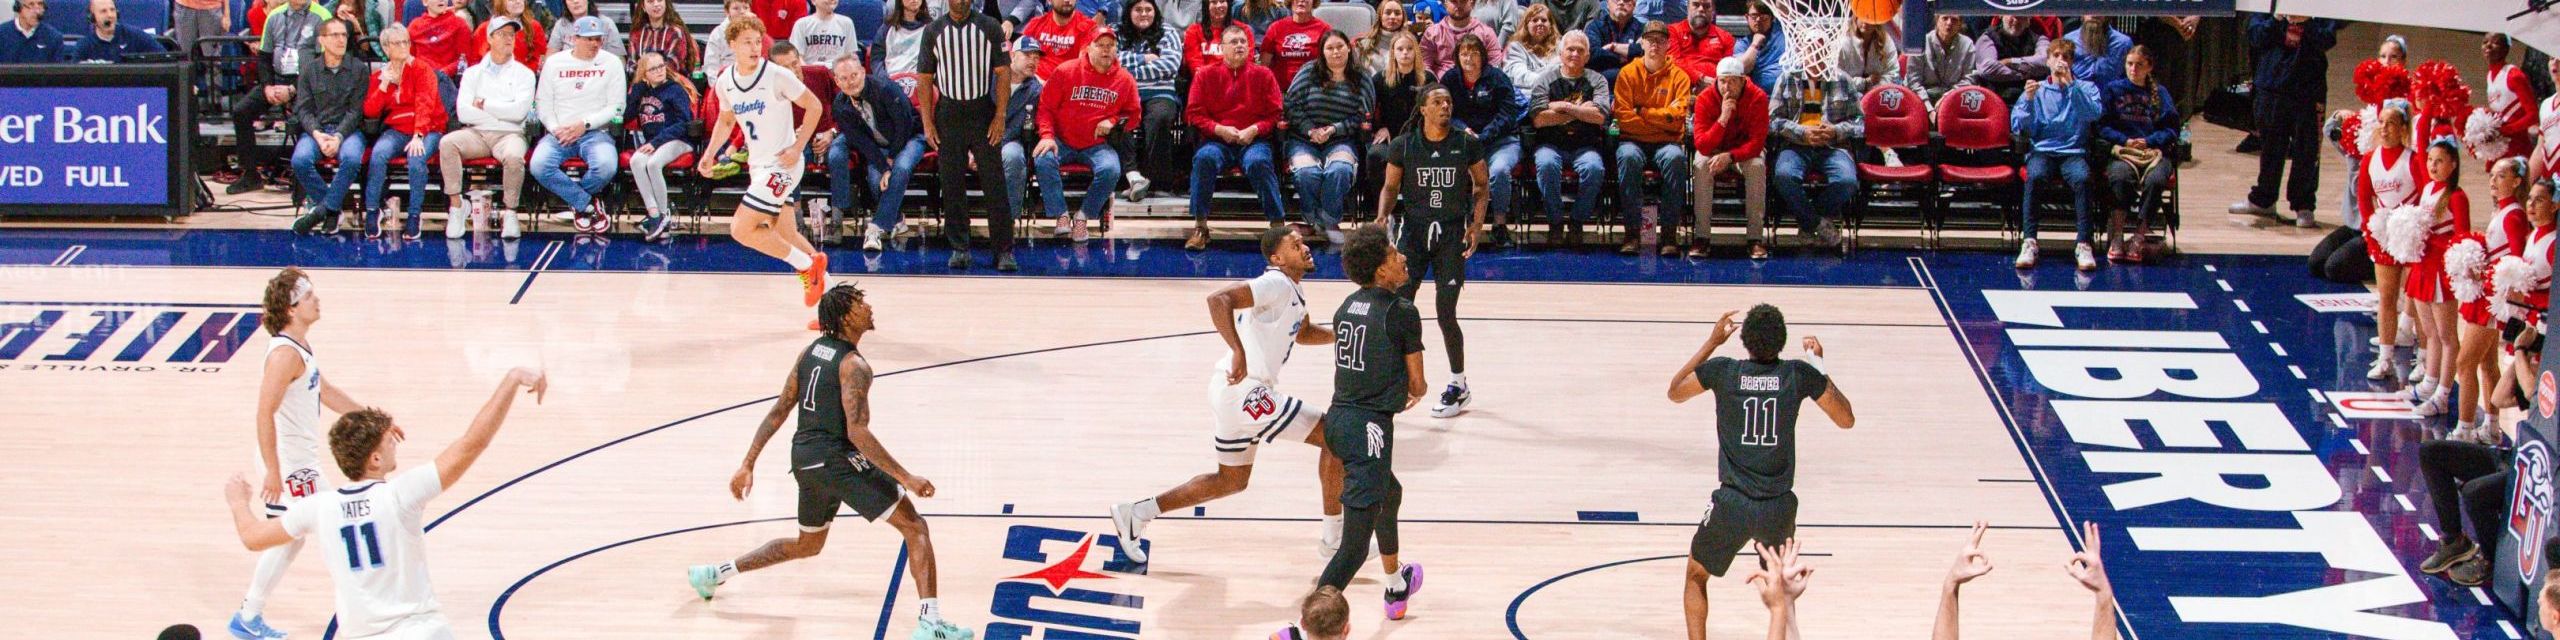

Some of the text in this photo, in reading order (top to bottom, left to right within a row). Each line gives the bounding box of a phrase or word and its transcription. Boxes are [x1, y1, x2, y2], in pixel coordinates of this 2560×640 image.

[805, 34, 846, 47] LIBERTY
[559, 70, 605, 78] LIBERTY
[1071, 86, 1118, 104] LIBERTY
[733, 99, 766, 115] Liberty
[54, 103, 167, 144] Bank
[745, 120, 758, 141] 2
[66, 166, 129, 187] FULL
[1417, 167, 1456, 188] FIU
[1430, 189, 1442, 208] 2
[1335, 320, 1367, 372] 21
[23, 364, 156, 372] ORVILLE
[803, 365, 821, 412] 1
[1740, 375, 1780, 391] BREWER
[1741, 396, 1778, 446] 11
[1981, 290, 2461, 640] LIBERTY
[341, 498, 371, 519] YATES
[340, 521, 385, 571] 11
